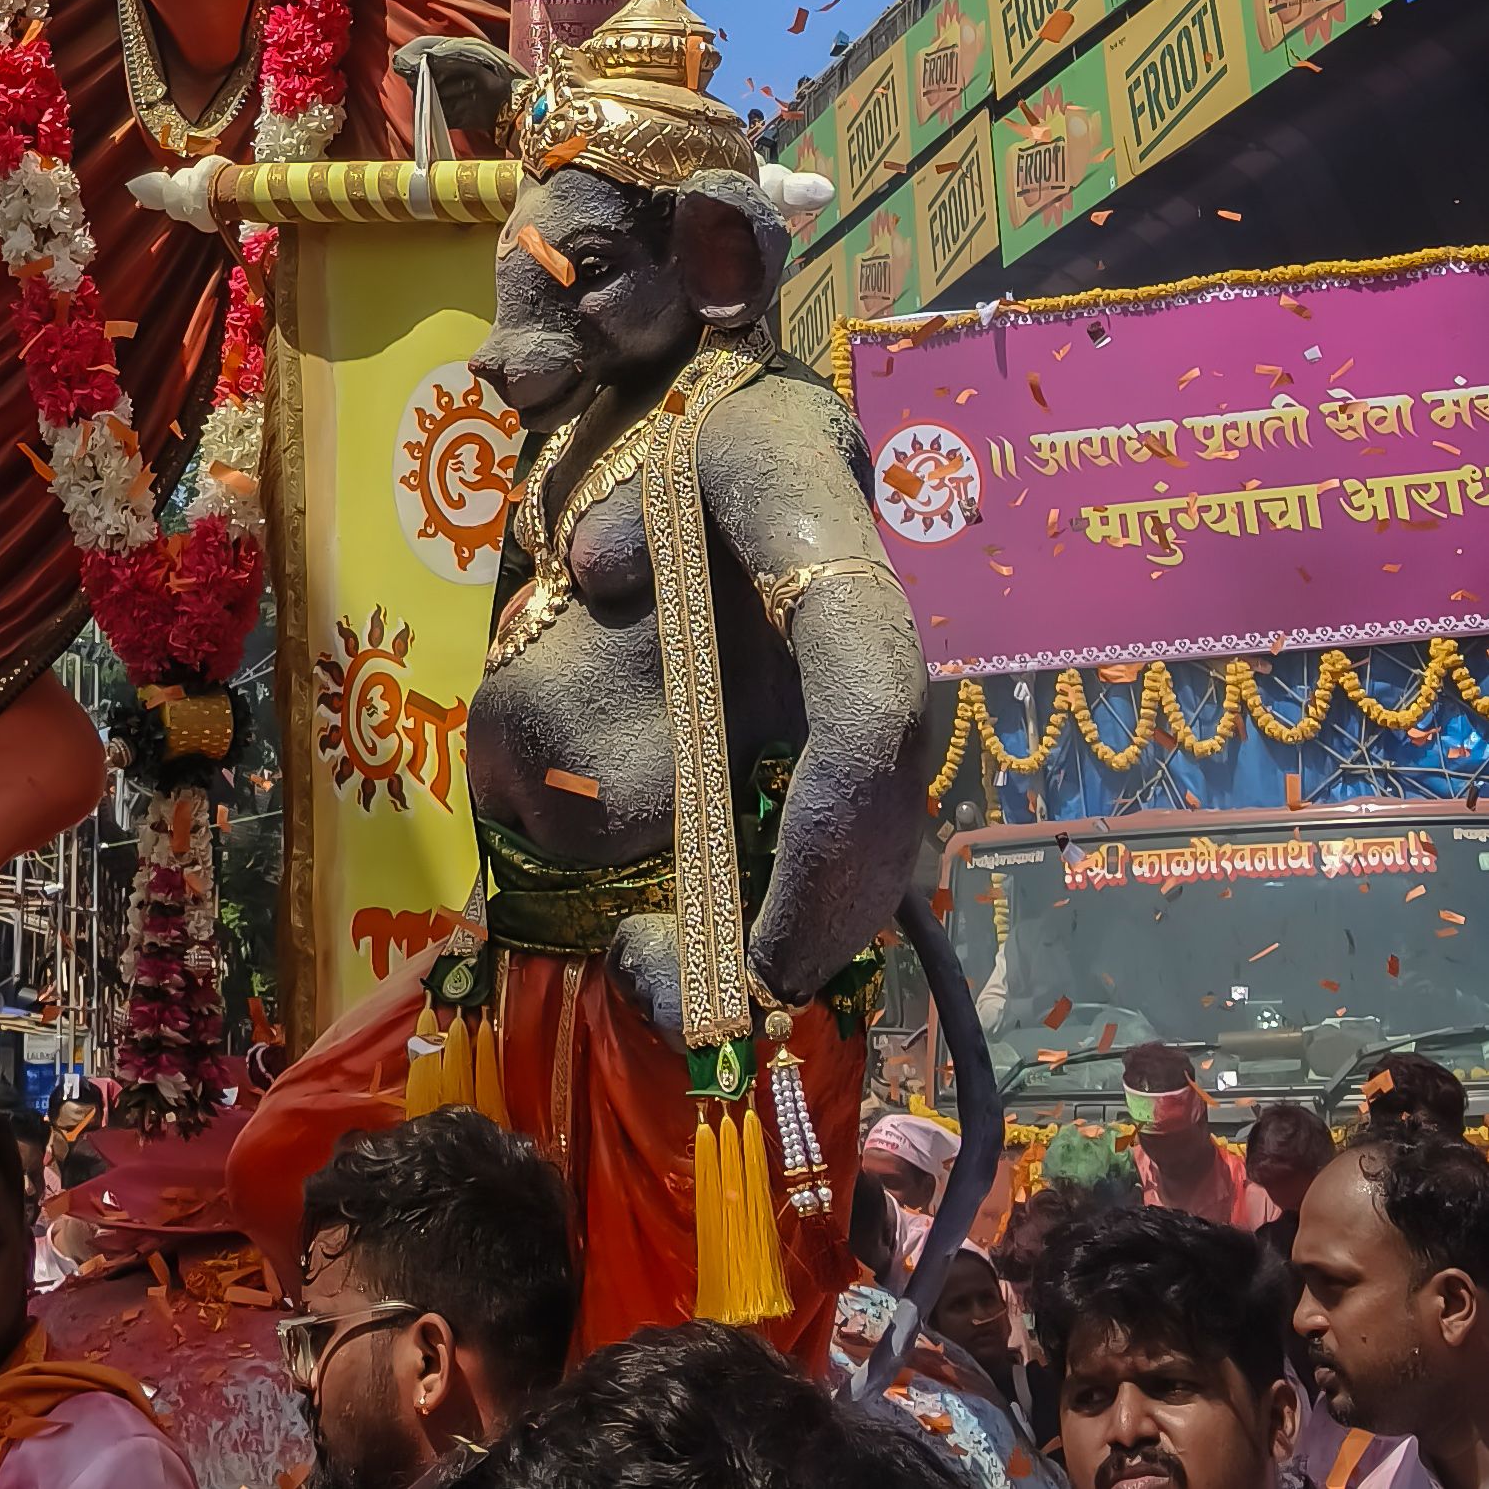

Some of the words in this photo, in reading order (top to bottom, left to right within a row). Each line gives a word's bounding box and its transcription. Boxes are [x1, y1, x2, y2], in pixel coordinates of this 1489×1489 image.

[922, 49, 959, 89] FROOTI
[847, 74, 900, 189] FROOTI
[1016, 144, 1066, 189] FROOTI
[928, 149, 985, 273] FROOTI
[860, 260, 892, 295] FROOTI
[1320, 388, 1420, 442] सेवा
